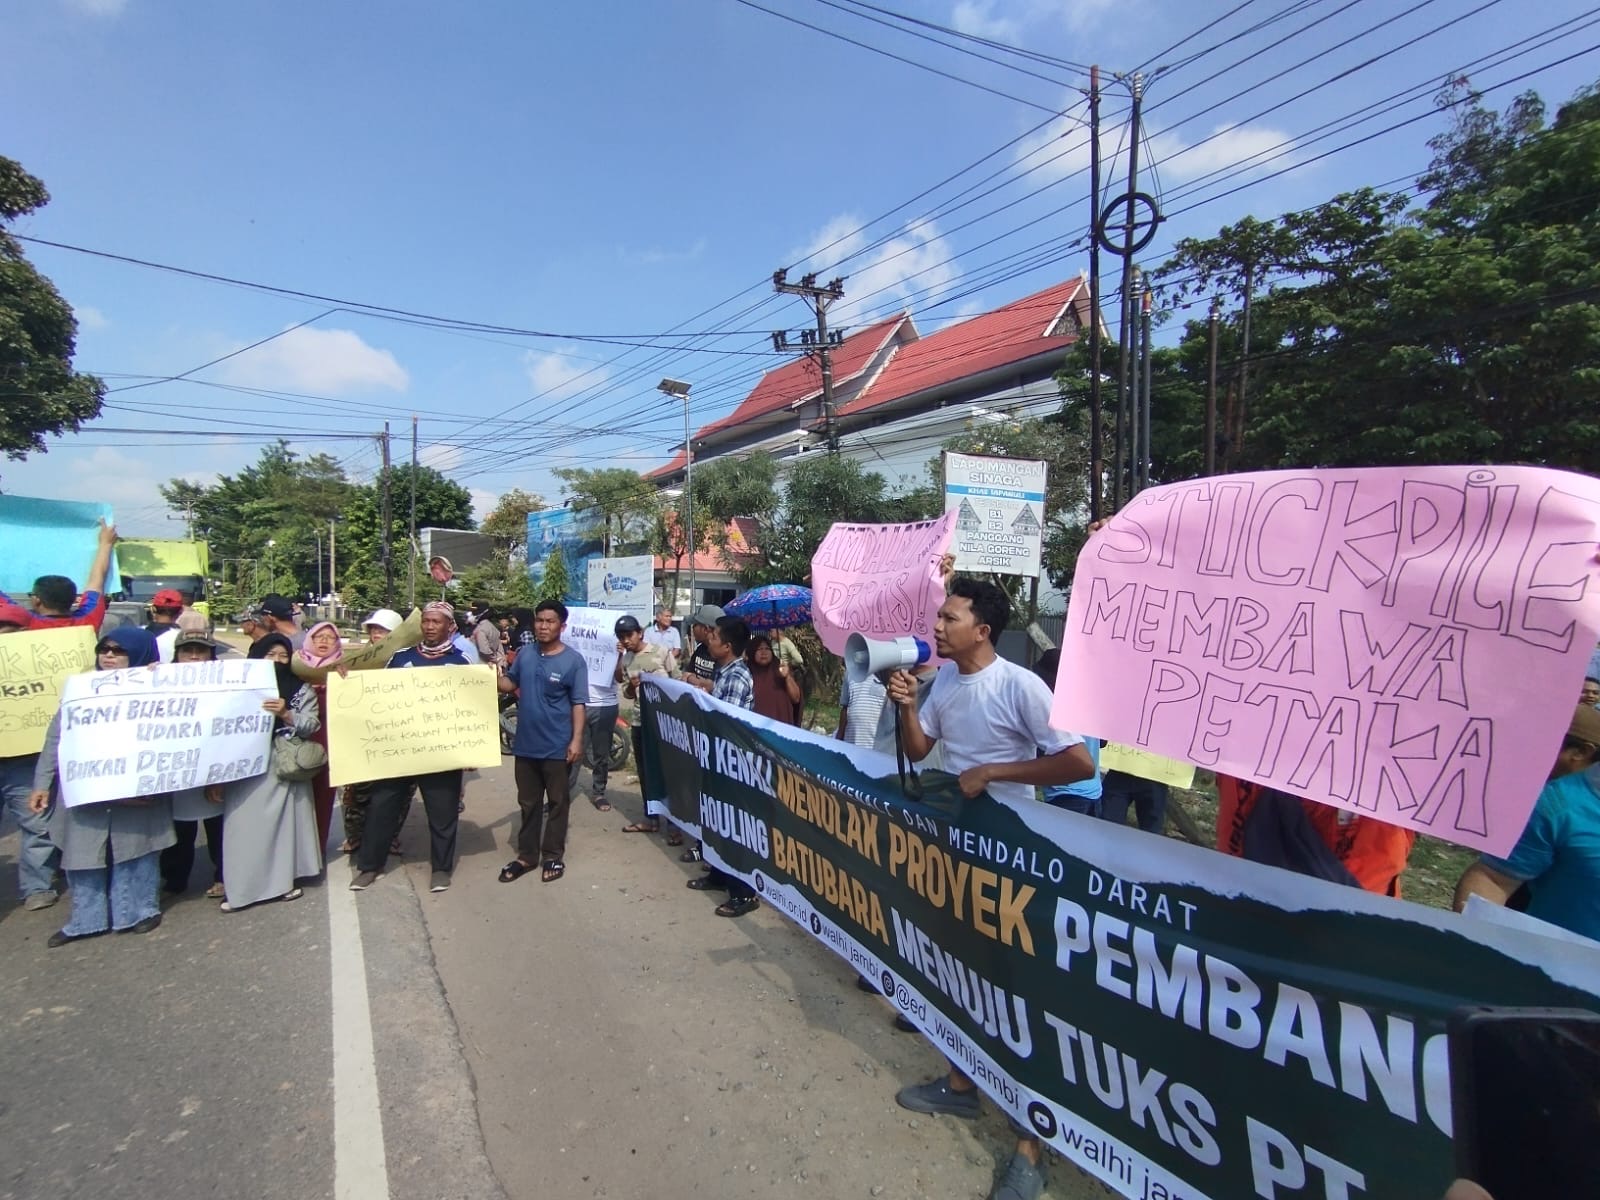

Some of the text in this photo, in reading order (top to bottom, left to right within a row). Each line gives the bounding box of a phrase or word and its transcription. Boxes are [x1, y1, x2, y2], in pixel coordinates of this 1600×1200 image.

[951, 458, 1040, 477] LAPO MANGAN
[969, 472, 1024, 488] SINAGA
[989, 509, 1003, 519] B1
[988, 520, 1003, 531] B2
[966, 531, 1025, 545] PANGGANG
[959, 542, 985, 553] NILA
[987, 544, 1030, 557] GORENG
[977, 556, 1012, 567] ARSIK
[571, 626, 598, 640] BUKAN
[136, 720, 202, 741] UDARA
[1136, 659, 1494, 838] PETAKA
[66, 747, 201, 783] BUKAN DEBU
[206, 755, 263, 785] BARA
[656, 710, 693, 756] WARGA
[776, 763, 882, 868] MENOLAK
[888, 821, 1037, 957] PROYEK
[903, 808, 938, 838] DAN
[949, 825, 1065, 884] MENDALO
[1088, 869, 1199, 932] DARAT
[700, 791, 1367, 1200] HOULING BATUBARA MENUJU TUKS PT
[1061, 1122, 1133, 1185] walhi
